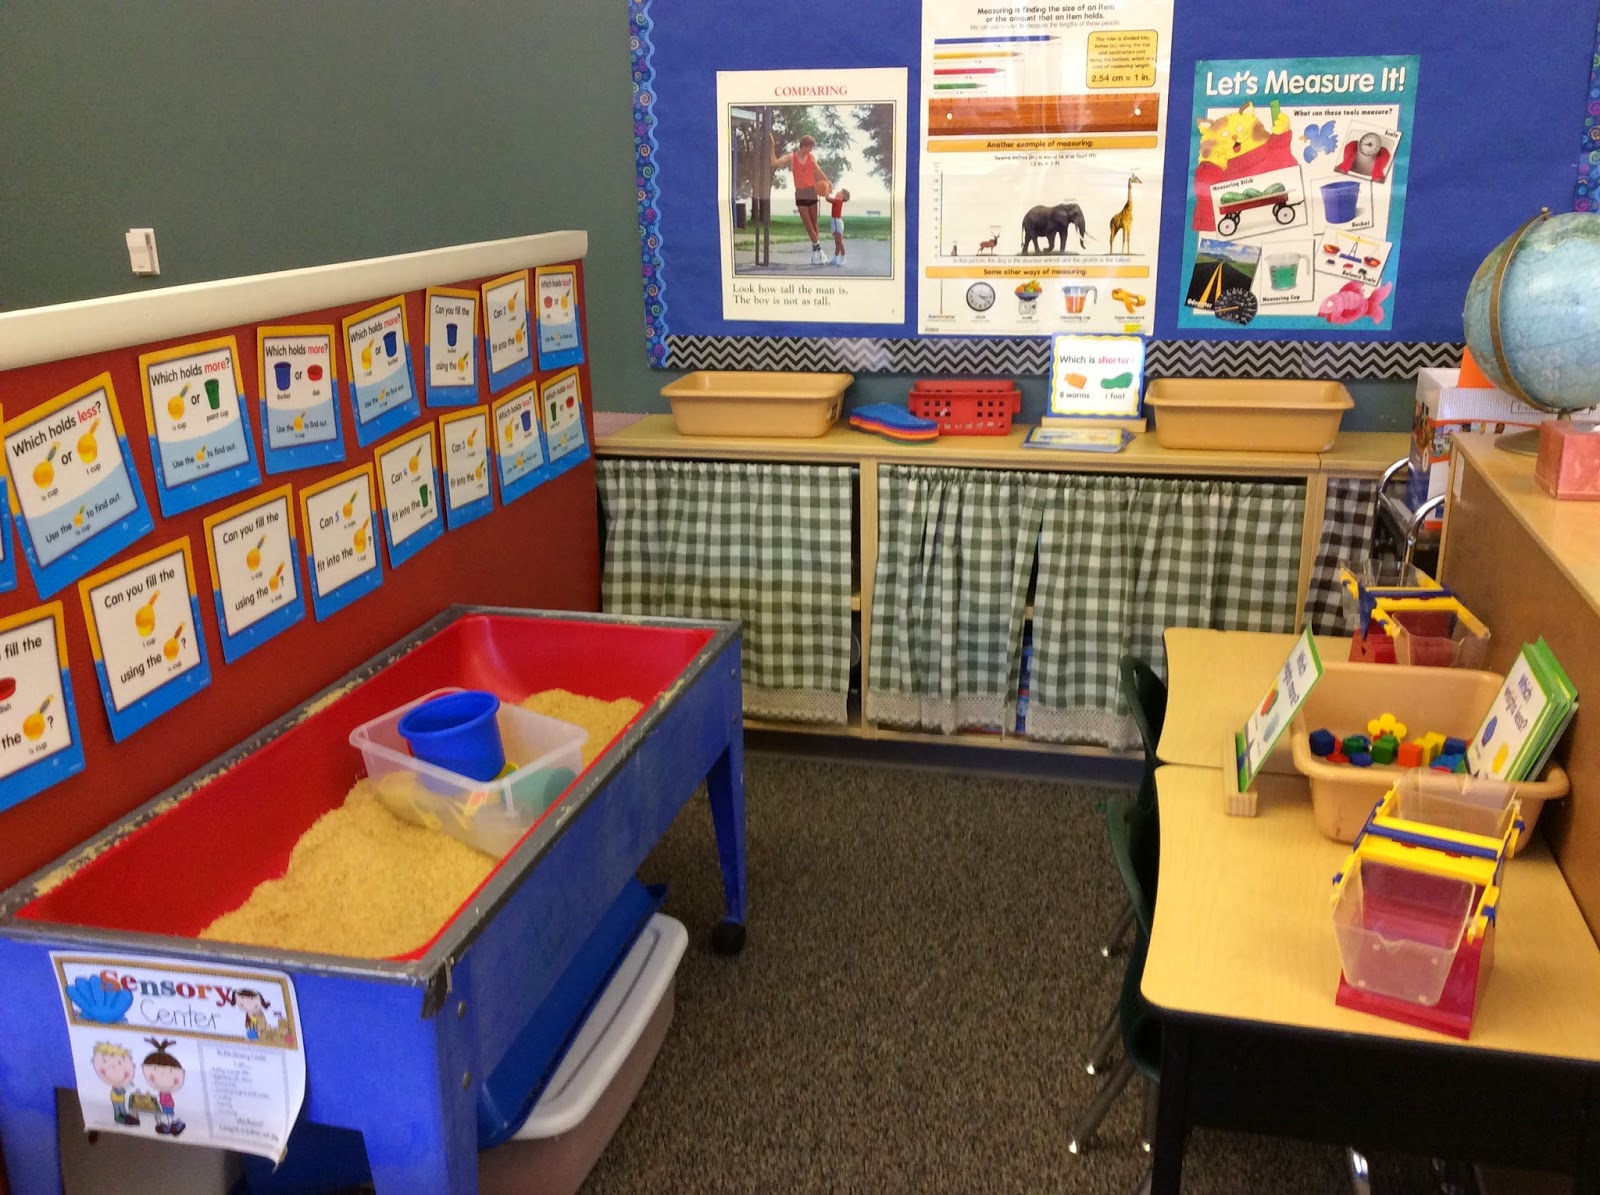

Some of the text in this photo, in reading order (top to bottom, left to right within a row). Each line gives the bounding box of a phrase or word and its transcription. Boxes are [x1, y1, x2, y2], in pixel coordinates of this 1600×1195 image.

[978, 7, 1012, 15] Measuring
[1022, 6, 1046, 14] finding
[1091, 74, 1109, 82] 2.54
[1206, 67, 1406, 96] Let's Measure It!
[774, 86, 848, 97] COMPARING
[1384, 130, 1399, 138] Scale
[1016, 141, 1045, 149] example
[1213, 178, 1254, 192] Measuring Stick
[1351, 220, 1370, 228] Bucket
[1342, 270, 1376, 284] Balance Scale
[733, 284, 848, 294] Look how tall the man is.
[733, 295, 750, 304] The
[754, 295, 769, 305] boy
[773, 296, 780, 304] is
[784, 297, 798, 305] not
[814, 297, 830, 306] tall.
[435, 305, 444, 314] Can
[445, 307, 454, 316] you
[462, 307, 470, 316] the
[494, 308, 503, 319] Can
[350, 313, 400, 343] Which holds more?
[266, 343, 328, 357] Which holds more?
[498, 341, 507, 351] into
[507, 337, 515, 347] the
[375, 346, 381, 355] or
[1060, 356, 1086, 364] Which
[1089, 356, 1096, 364] is
[151, 357, 230, 386] Which holds more?
[436, 360, 457, 373] using the
[295, 371, 302, 380] or
[191, 394, 200, 406] or
[206, 410, 229, 422] paint cup
[12, 400, 102, 457] Which holds less?
[177, 422, 186, 430] cup
[310, 420, 319, 428] find
[451, 443, 462, 453] Can
[61, 451, 72, 464] or
[173, 460, 184, 468] Use
[185, 456, 194, 464] the
[214, 445, 226, 454] find
[91, 463, 101, 473] cup
[391, 472, 402, 484] Can
[456, 476, 466, 486] into
[47, 488, 59, 498] cup
[399, 506, 410, 518] into
[411, 500, 420, 510] the
[46, 531, 60, 542] Use
[60, 523, 72, 534] the
[86, 510, 94, 518] to
[95, 499, 108, 512] find
[320, 511, 339, 529] Can 5
[81, 524, 91, 532] cup
[223, 511, 279, 544] Can you fill the
[326, 554, 340, 568] into
[342, 548, 353, 560] the
[104, 569, 175, 608] Can you fill the
[235, 586, 268, 611] using the
[5, 636, 42, 659] fill the
[146, 637, 156, 646] cup
[120, 662, 145, 684] using
[146, 653, 162, 668] the
[173, 661, 182, 670] cup
[1518, 672, 1533, 703] Which
[2, 733, 22, 749] the
[36, 741, 47, 751] cup
[100, 969, 233, 1007] Sensory
[140, 999, 221, 1030] Center
